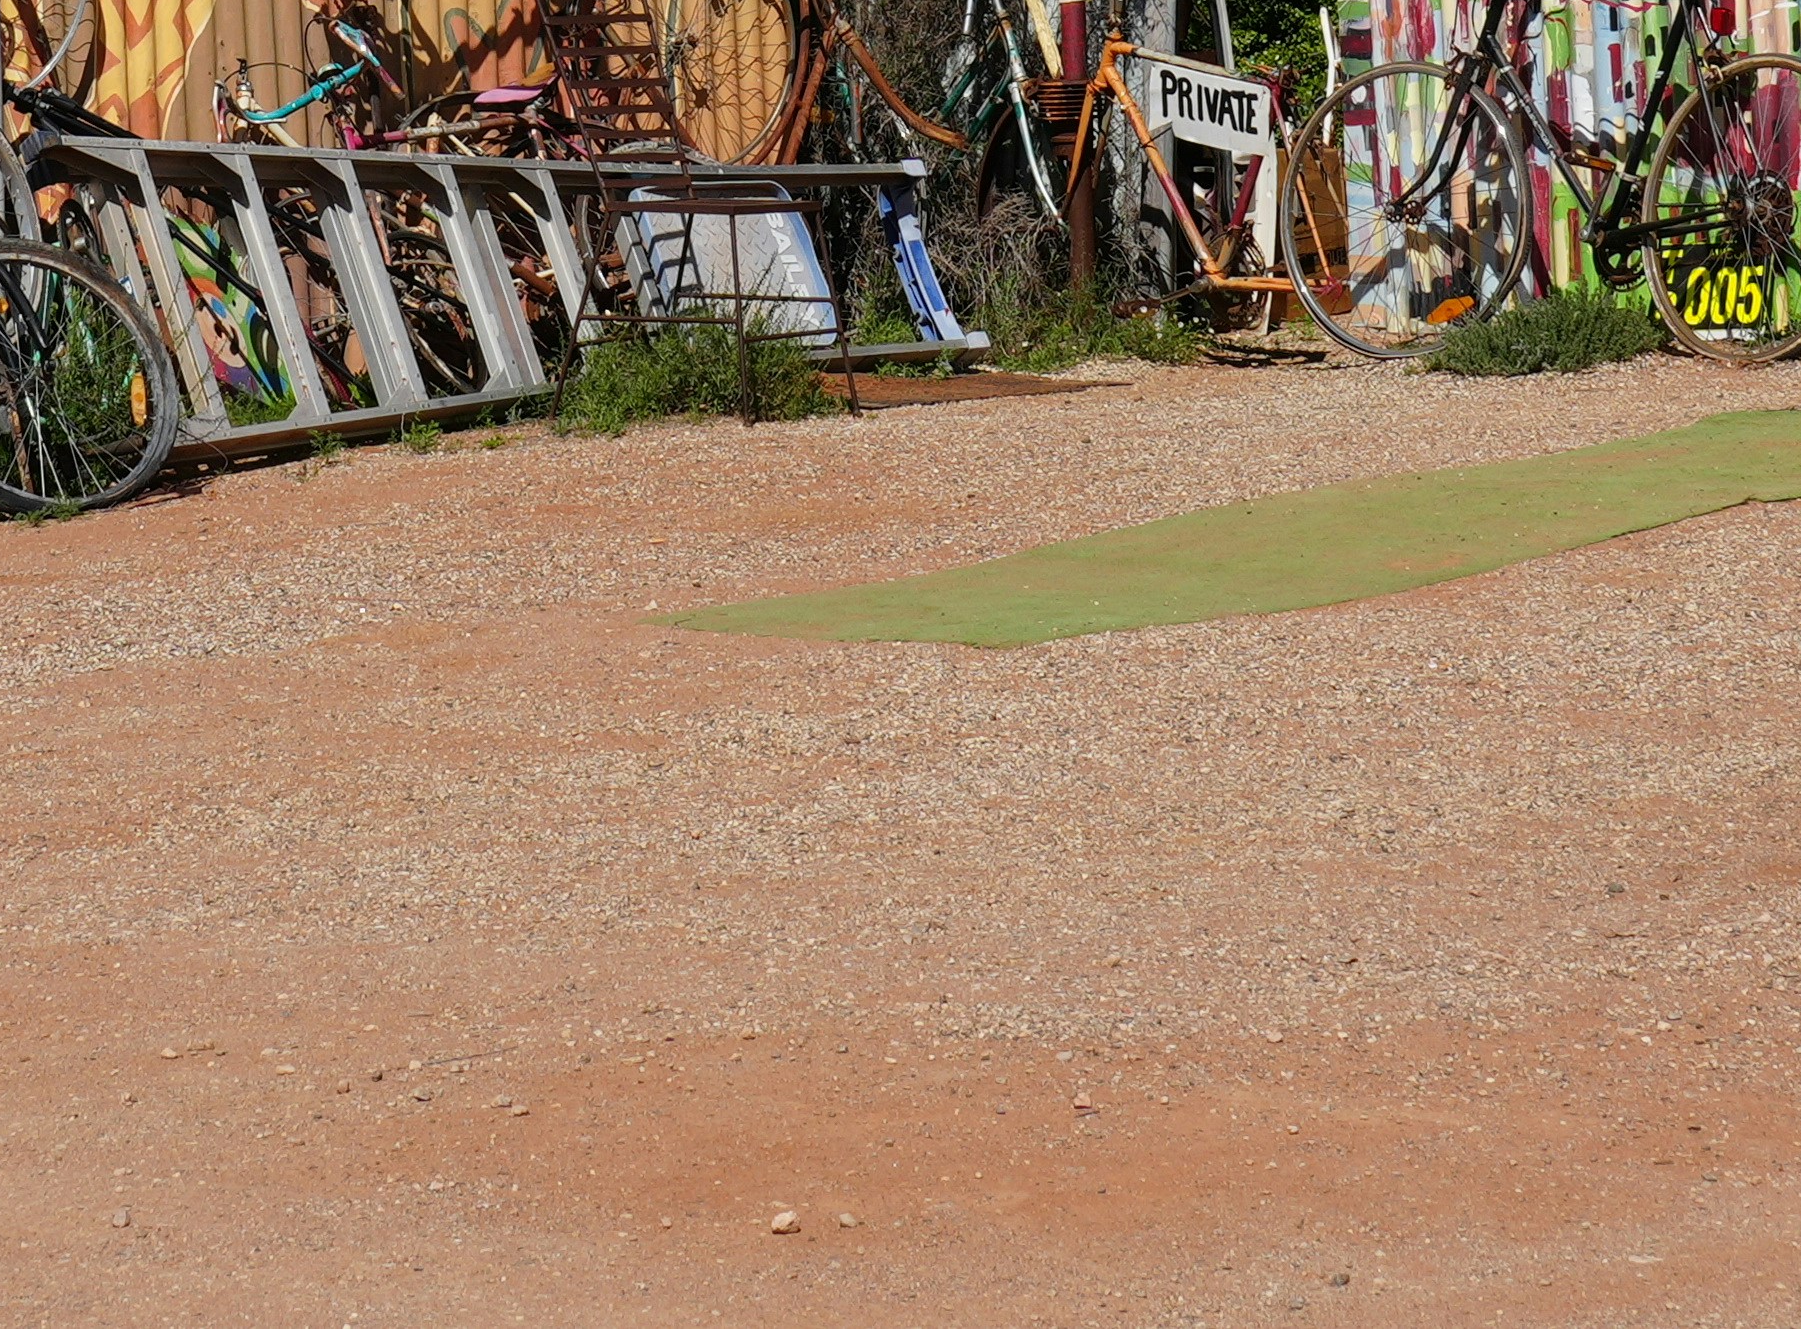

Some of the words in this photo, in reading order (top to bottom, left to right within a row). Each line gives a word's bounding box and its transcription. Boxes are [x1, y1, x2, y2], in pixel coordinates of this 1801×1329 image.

[1160, 70, 1259, 135] PRIVATE
[766, 212, 820, 327] BAILEY
[1684, 265, 1765, 325] 005
